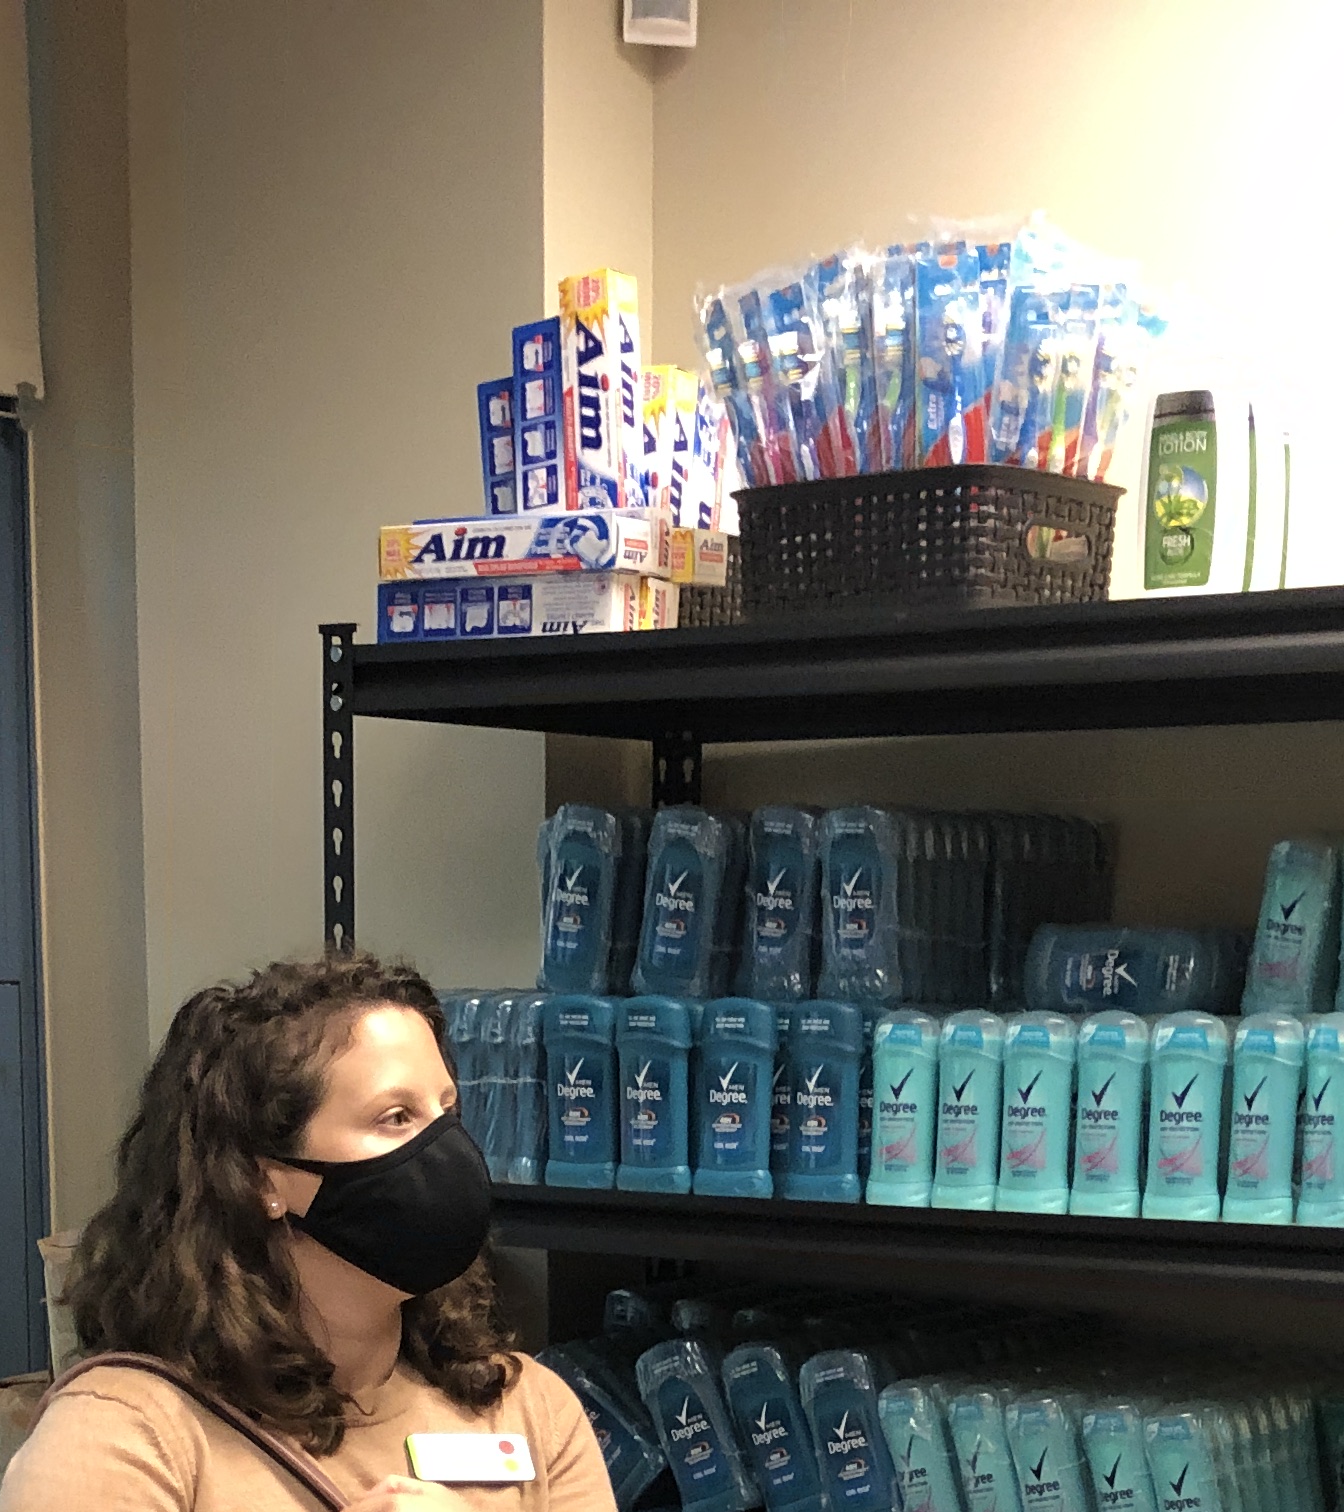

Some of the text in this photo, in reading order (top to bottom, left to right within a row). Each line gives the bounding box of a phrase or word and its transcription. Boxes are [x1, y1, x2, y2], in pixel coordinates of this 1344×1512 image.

[618, 312, 638, 429] Aim
[575, 311, 609, 451] Aim
[1158, 437, 1207, 456] LOTION
[411, 527, 507, 564] Aim
[1162, 534, 1191, 548] FRESH
[656, 893, 695, 912] Degree
[757, 893, 795, 911] Degree
[833, 895, 875, 912] Degree
[558, 1083, 596, 1100] Degree
[626, 1086, 663, 1103] Degree
[709, 1089, 748, 1106] Degree
[796, 1091, 834, 1108] Degree
[879, 1101, 918, 1115] Degree
[942, 1102, 978, 1117] Degree
[1007, 1104, 1046, 1120] Degree
[1081, 1107, 1119, 1123] Degree
[1159, 1109, 1203, 1124] Degree
[1233, 1111, 1270, 1127] Degree
[671, 1419, 711, 1442] Degree
[752, 1425, 789, 1446] Degree
[827, 1434, 869, 1454] Degree
[1024, 1479, 1061, 1496] Degree
